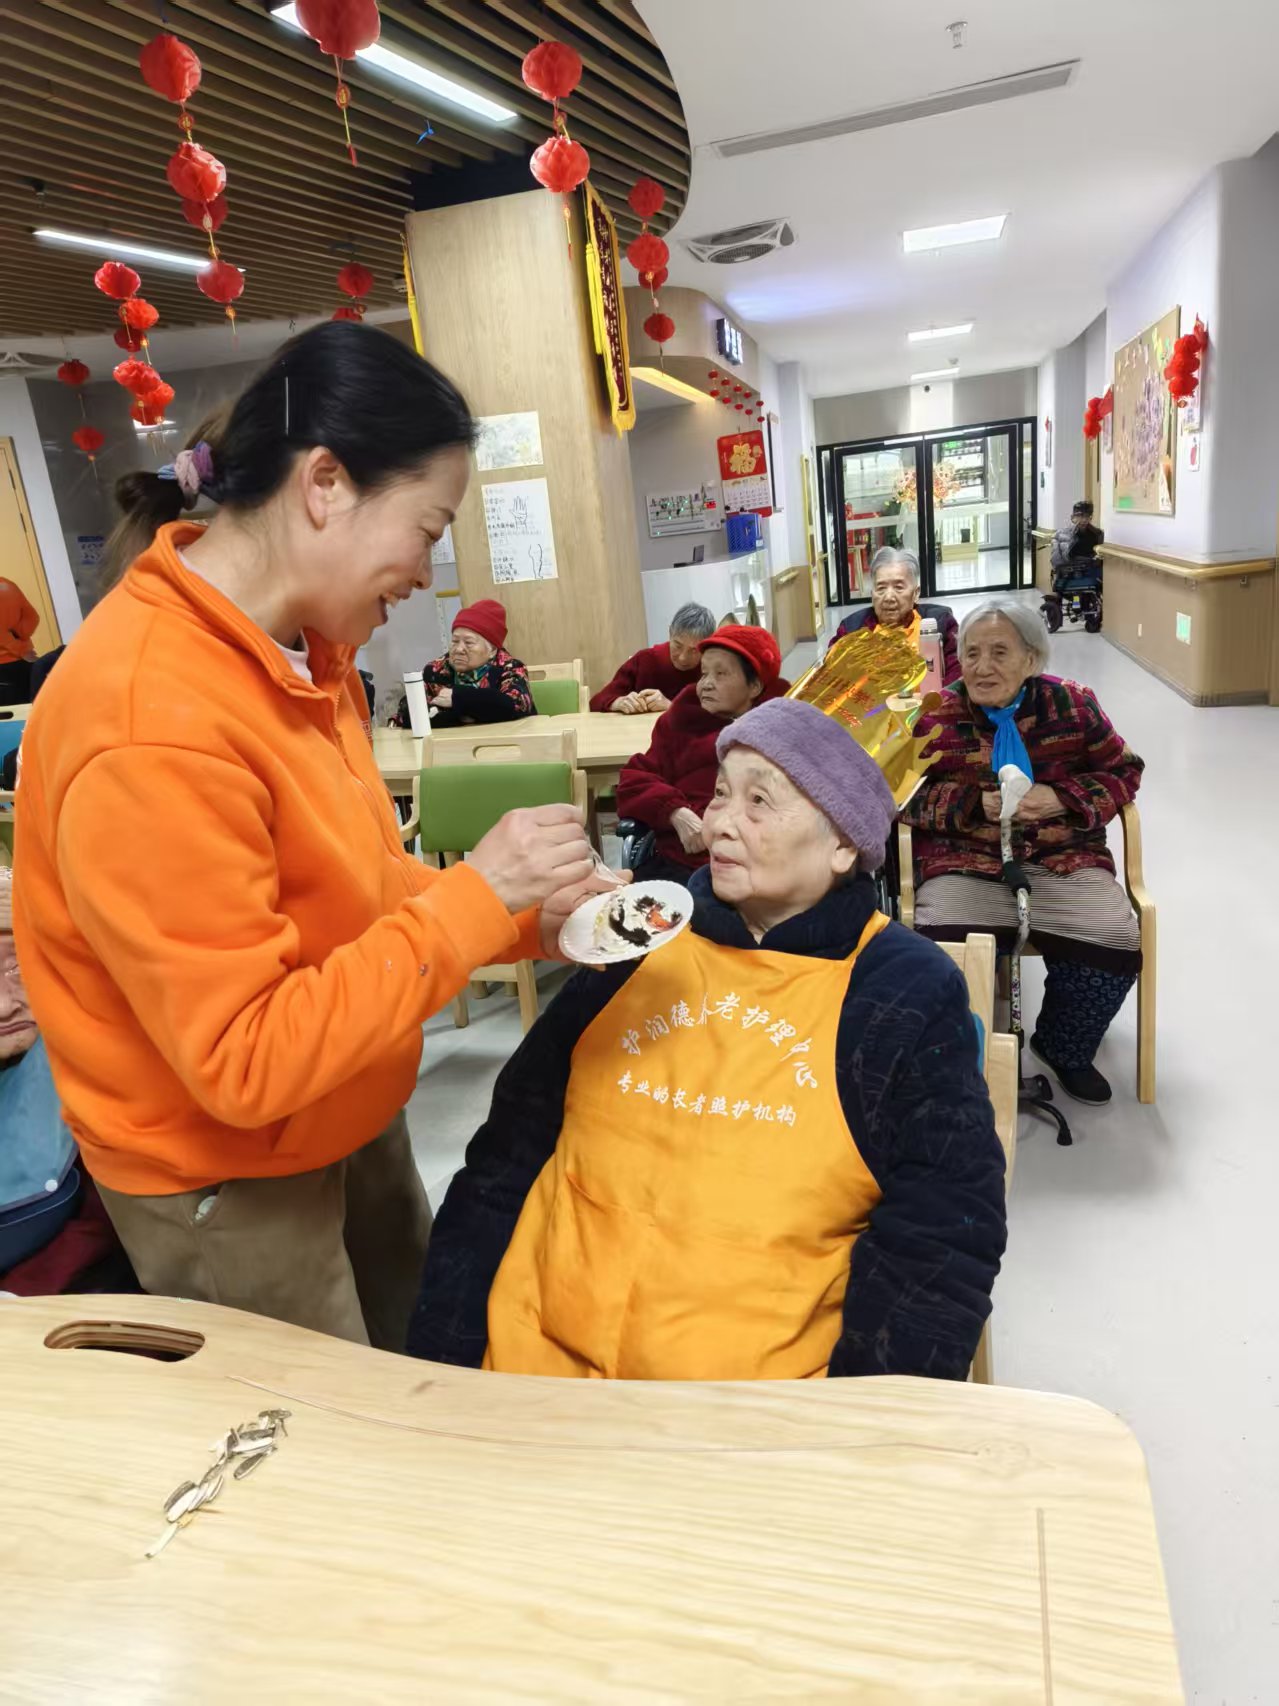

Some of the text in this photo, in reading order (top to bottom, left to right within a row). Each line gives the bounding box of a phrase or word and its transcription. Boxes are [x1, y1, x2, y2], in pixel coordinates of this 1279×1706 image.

[617, 1070, 797, 1127] 专业的长者照护机构
